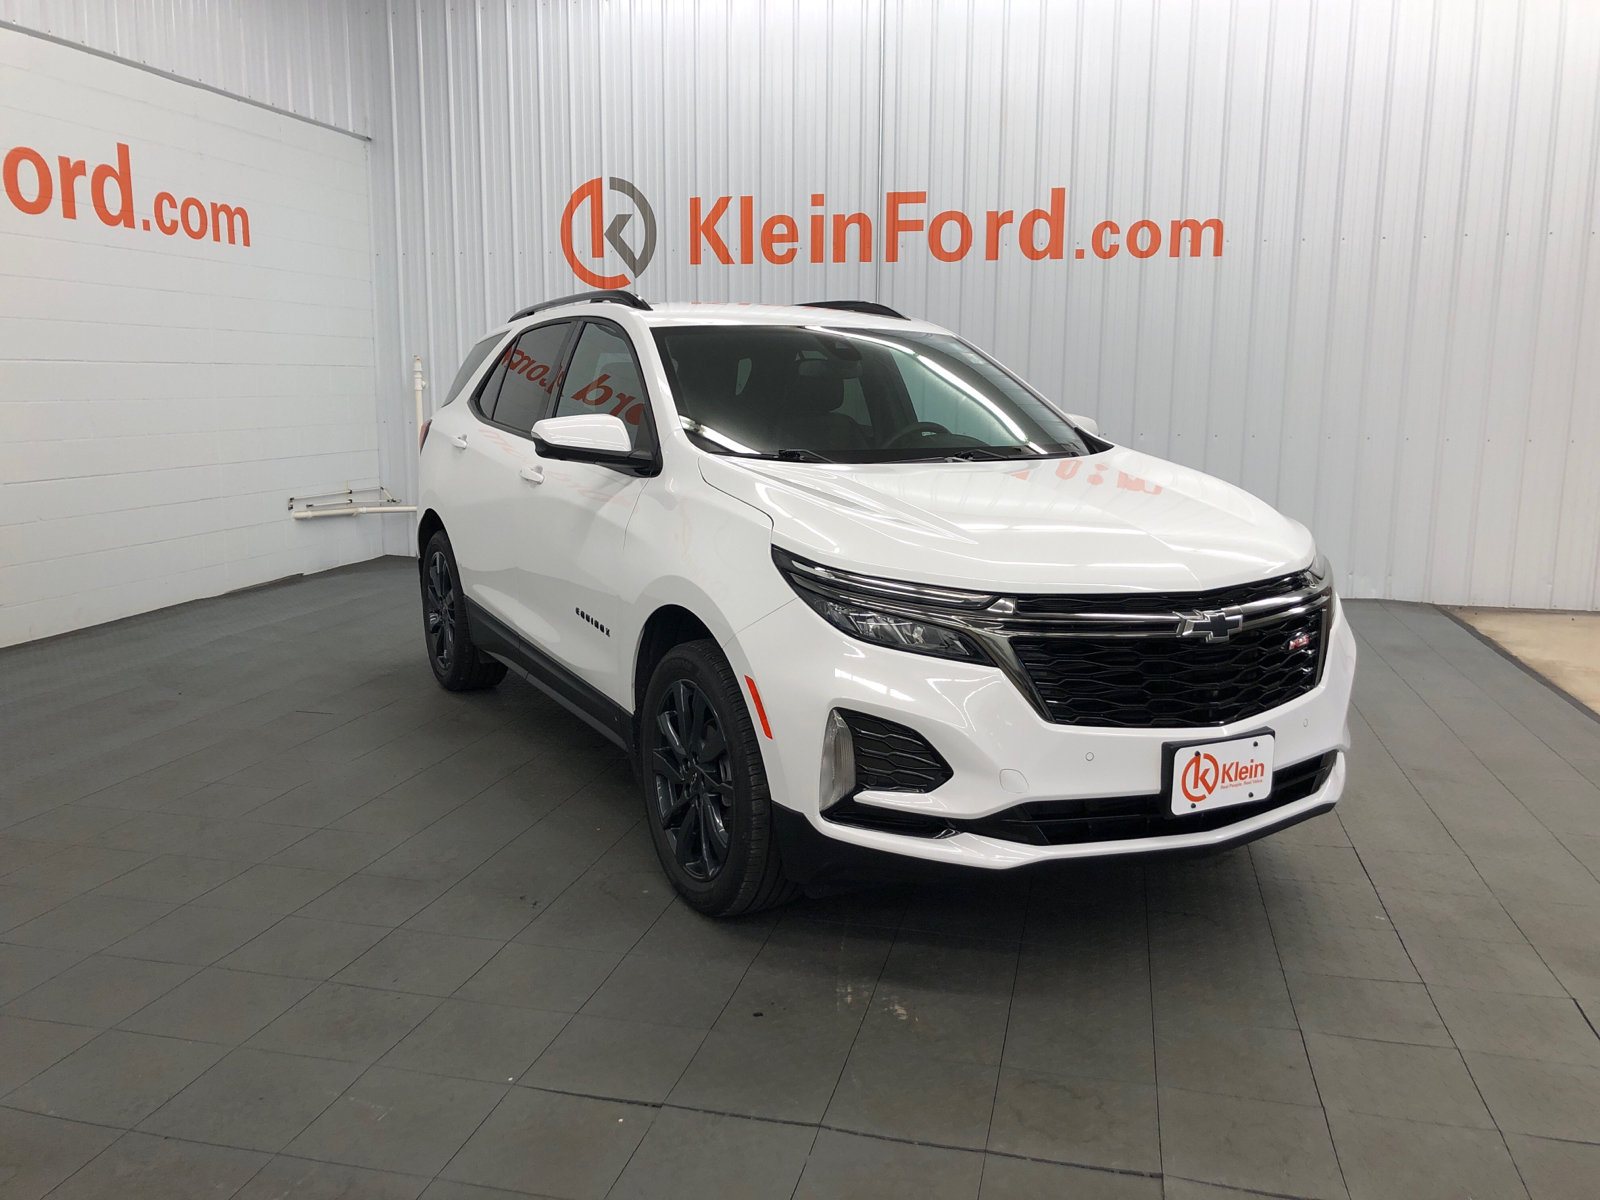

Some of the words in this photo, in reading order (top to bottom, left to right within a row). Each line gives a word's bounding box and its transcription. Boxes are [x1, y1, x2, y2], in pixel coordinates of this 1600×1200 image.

[3, 142, 250, 247] ord.com
[689, 187, 1224, 265] KleinFord.com
[1221, 759, 1265, 784] Klein
